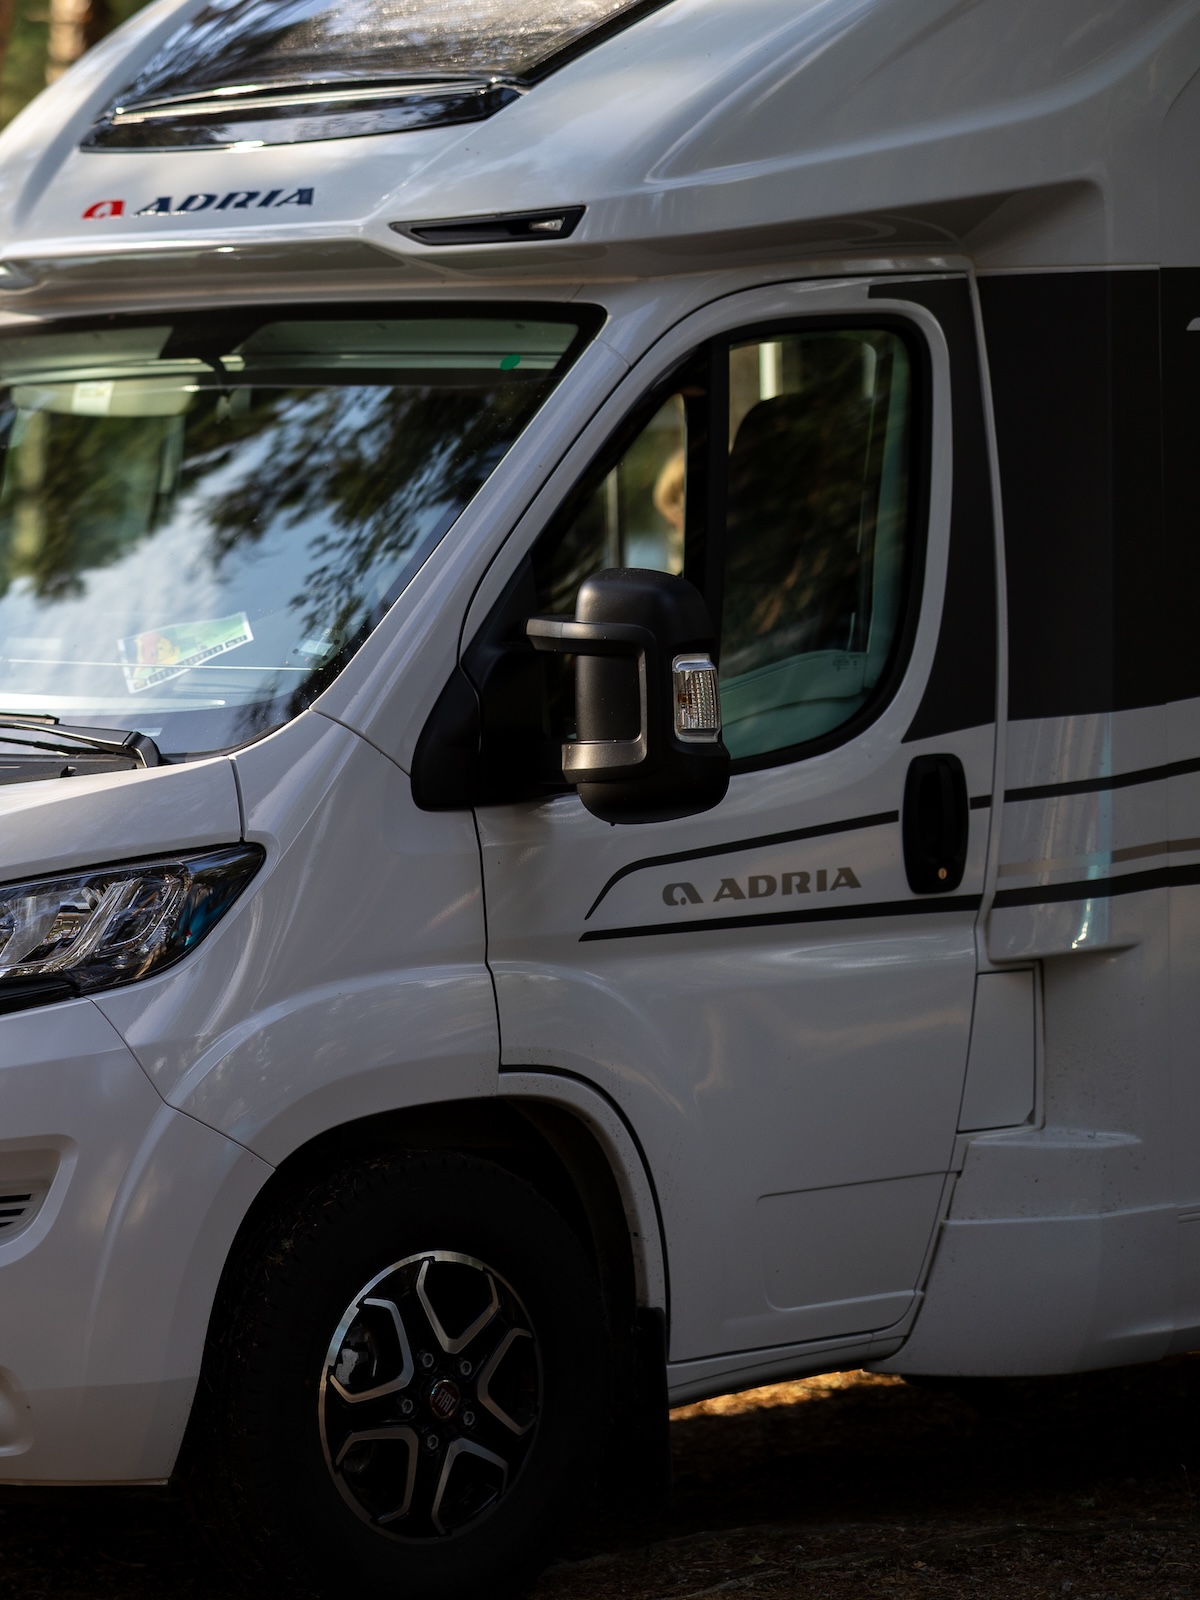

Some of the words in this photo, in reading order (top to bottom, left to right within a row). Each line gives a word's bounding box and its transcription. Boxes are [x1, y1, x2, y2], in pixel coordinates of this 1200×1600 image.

[131, 187, 315, 217] ADRIA
[712, 867, 862, 902] ADRIA
[434, 1387, 456, 1413] FIAT
